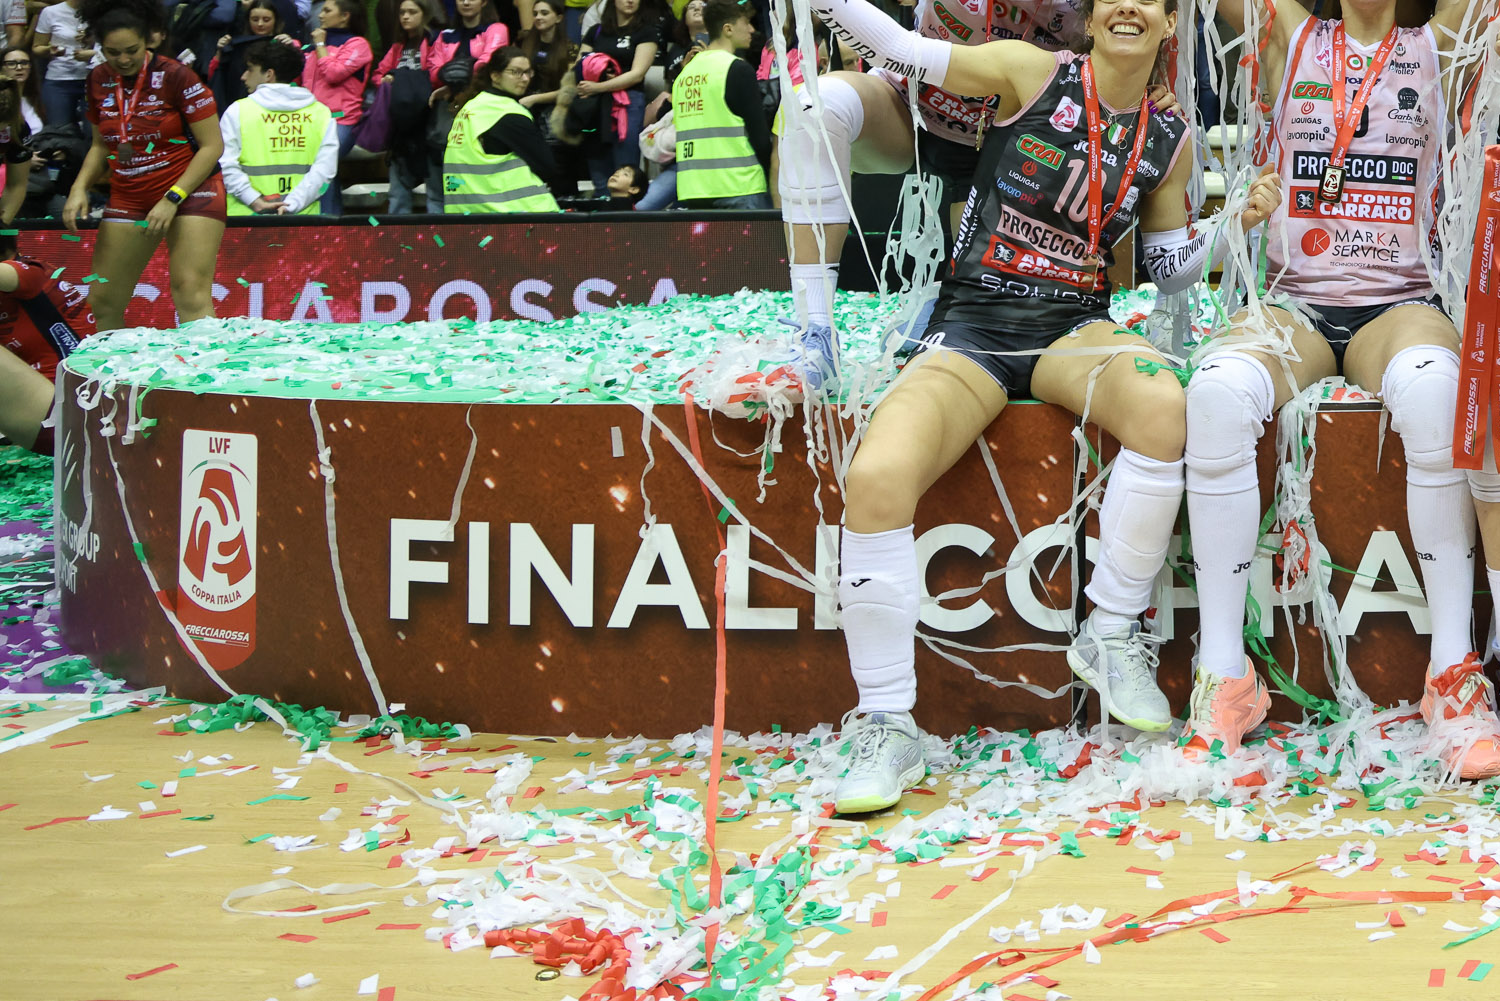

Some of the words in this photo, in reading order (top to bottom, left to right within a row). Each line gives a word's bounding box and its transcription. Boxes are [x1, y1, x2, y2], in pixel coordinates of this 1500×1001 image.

[936, 2, 972, 40] CRAI
[821, 17, 877, 60] ATELIER
[677, 73, 708, 87] WORK
[684, 87, 701, 99] ON
[678, 100, 704, 113] TIME
[261, 113, 312, 124] WORK
[1291, 117, 1322, 125] LIQUIGAS
[278, 125, 302, 136] ON
[269, 137, 306, 148] TIME
[683, 141, 694, 158] 50
[1020, 138, 1062, 168] CRAI
[1090, 140, 1098, 182] FRECCIAROSSA
[1297, 155, 1387, 180] PROECCO
[1391, 160, 1414, 175] DOC
[1008, 168, 1041, 191] LIQUIGAS
[1052, 158, 1107, 223] 10
[1341, 192, 1413, 206] TONIO
[1319, 202, 1412, 221] CARRARO
[1001, 208, 1087, 261] PROSECCO
[1335, 229, 1401, 248] MARKA
[1331, 244, 1400, 263] SERVICE
[1479, 216, 1495, 294] FRECCIAROSSA
[1464, 377, 1478, 455] FRECCIAROSSA
[208, 437, 231, 454] LVF
[388, 518, 841, 630] FINALI
[1232, 560, 1251, 574] Jo
[191, 583, 215, 606] COPPA
[216, 589, 242, 606] ITALIA
[185, 624, 250, 642] FRECCIAROSSA
